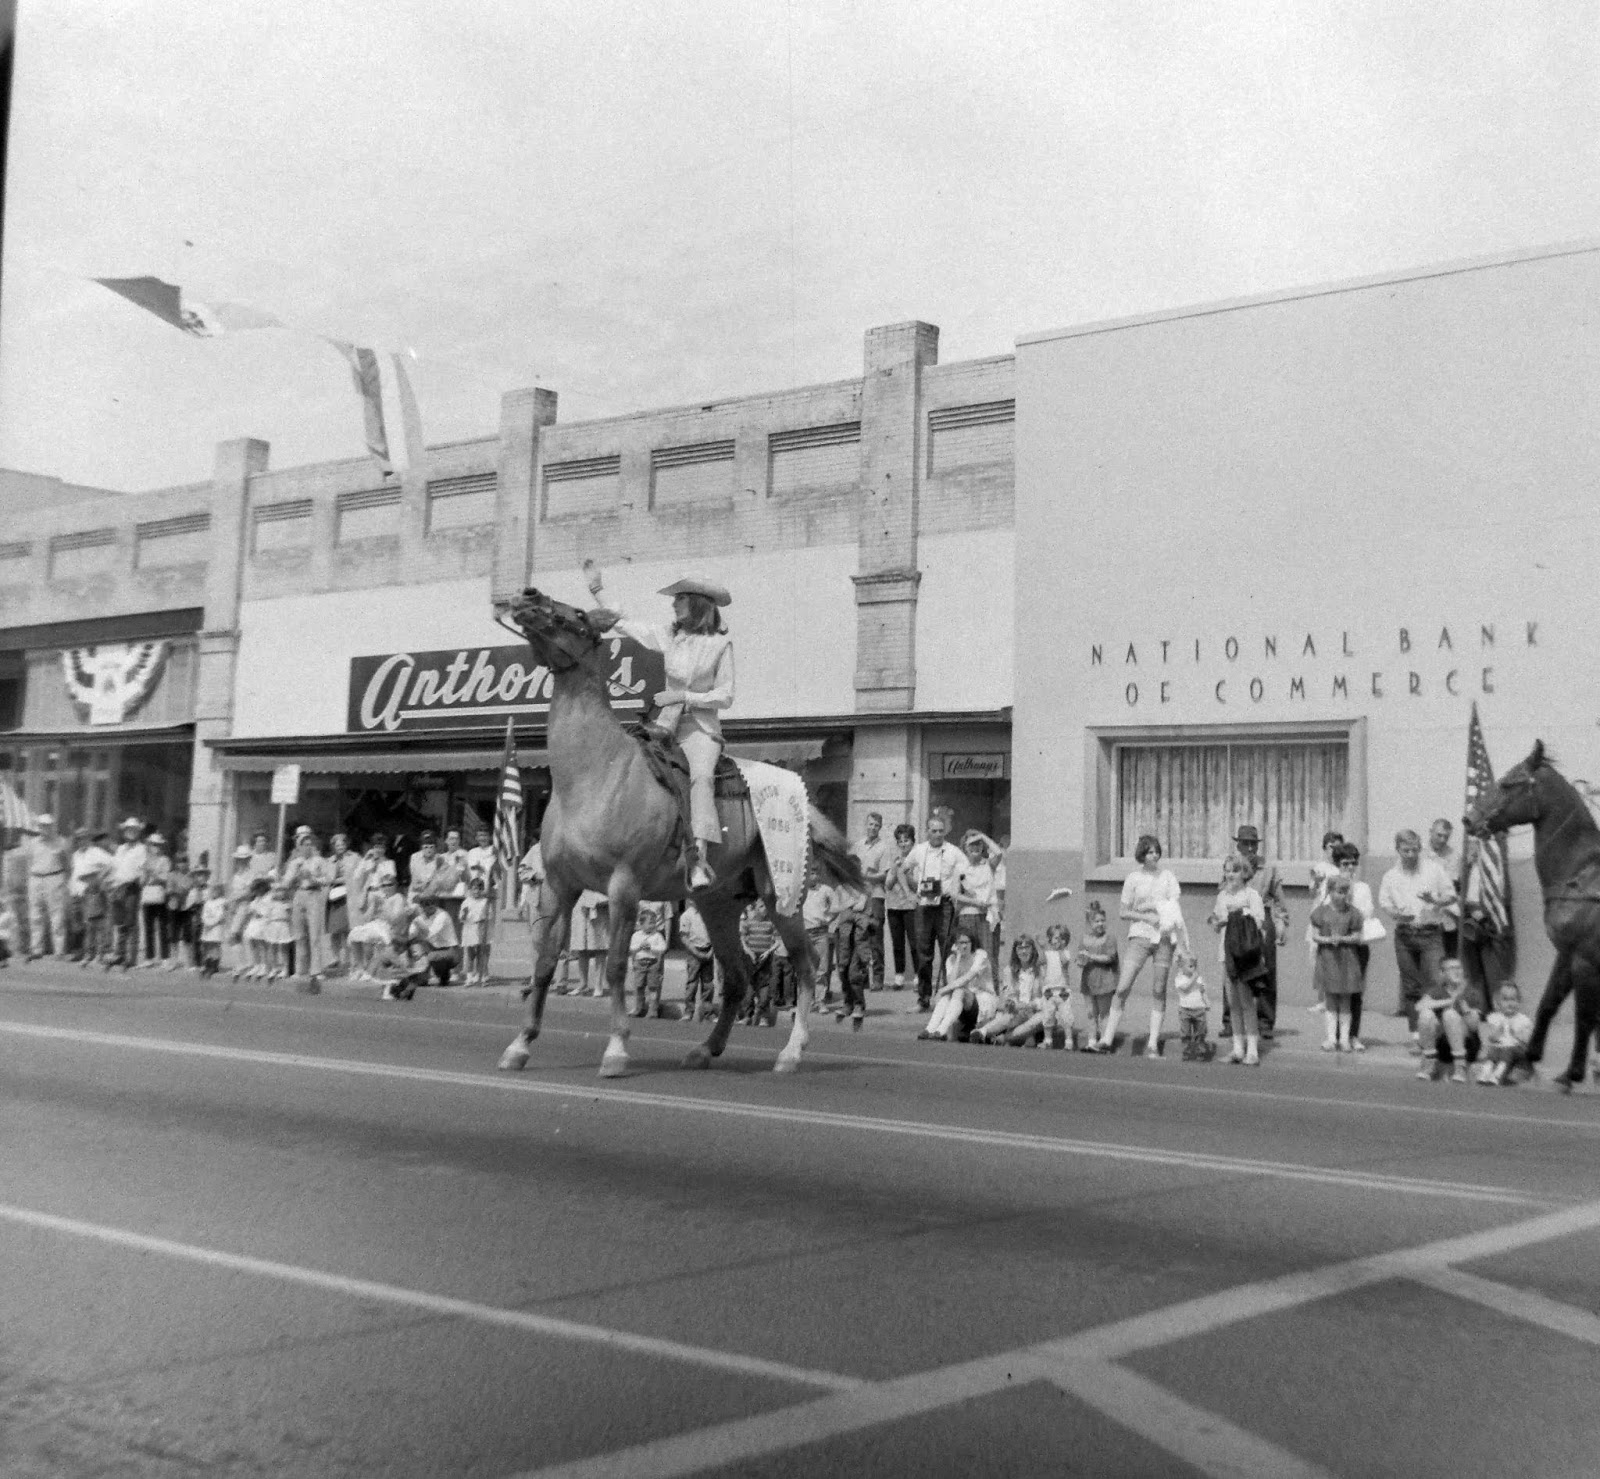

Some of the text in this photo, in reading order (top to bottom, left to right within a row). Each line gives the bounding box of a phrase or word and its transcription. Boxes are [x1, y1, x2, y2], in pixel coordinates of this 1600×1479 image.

[1091, 621, 1539, 666] NATIONAL BANK
[360, 638, 647, 731] Anthon's
[1215, 667, 1494, 704] COMMERCE
